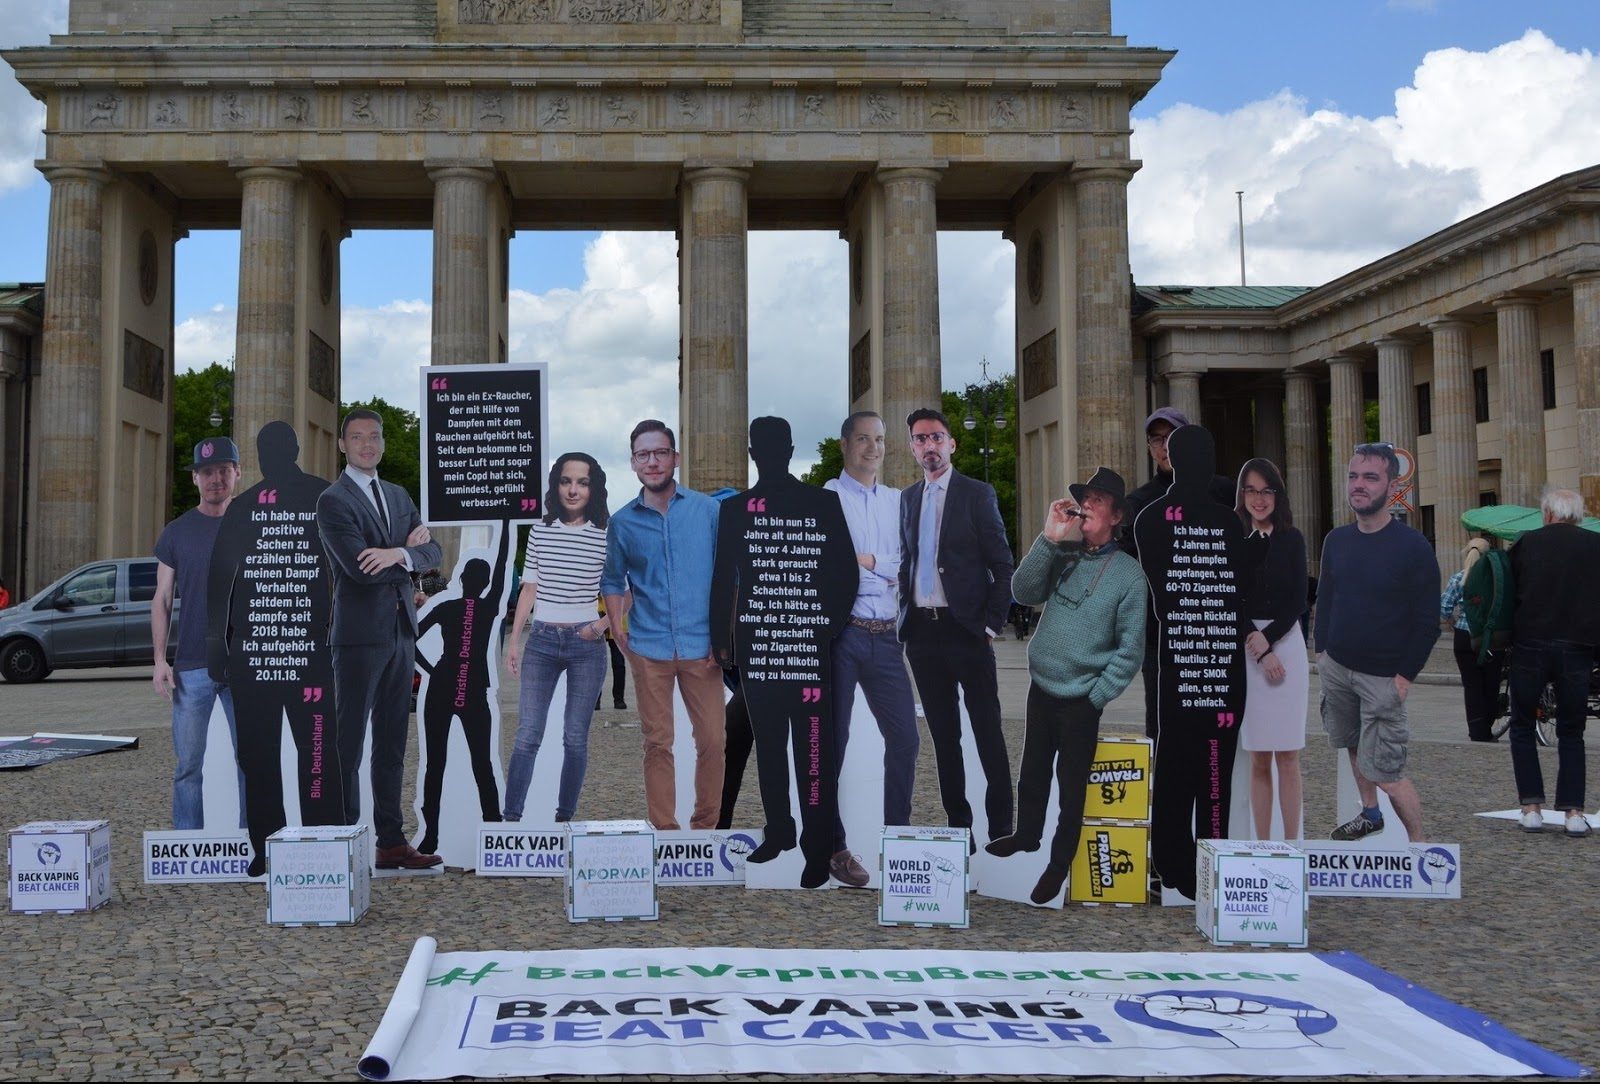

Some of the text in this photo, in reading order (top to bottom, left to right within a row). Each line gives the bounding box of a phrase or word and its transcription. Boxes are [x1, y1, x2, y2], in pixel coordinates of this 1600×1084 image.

[437, 392, 532, 402] Ich bin ein Ex-Raucher,
[450, 405, 519, 414] der mit Hilfe von
[448, 418, 521, 429] Dampfen mit dem
[436, 431, 534, 441] Rauchen aufgehört hat.
[438, 444, 532, 454] Seit dem bekomme ich
[439, 458, 531, 468] besser Luft und sogar
[444, 471, 526, 482] mein Copd hat sich,
[446, 484, 524, 495] zumindest, gefühlt
[461, 498, 509, 507] verbessert.
[252, 510, 316, 520] Ich habe nur
[754, 517, 767, 526] Ich
[770, 517, 783, 526] bin
[805, 518, 816, 527] 53
[262, 525, 304, 537] positive
[744, 530, 826, 541] Jahre alt und habe
[1174, 526, 1186, 535] Ich
[1189, 526, 1208, 535] habe
[256, 539, 309, 549] Sachen zu
[749, 544, 762, 553] bis
[791, 546, 821, 555] Jahren
[1181, 540, 1225, 550] Jahren mit
[246, 553, 318, 563] erzählen über
[753, 558, 817, 569] stark geraucht
[1173, 554, 1227, 565] dem dampfen
[244, 568, 319, 580] meinen Dampf
[759, 573, 802, 582] etwa bis
[1167, 568, 1217, 580] angefangen,
[256, 582, 306, 592] Verhalten
[753, 586, 801, 596] Schachteln
[1166, 583, 1236, 594] 60-70 Zigaretten
[250, 597, 311, 607] seitdem ich
[748, 600, 808, 611] Tag. Ich hätte
[1179, 597, 1224, 606] ohne einen
[249, 611, 311, 624] dampfe seit
[740, 614, 829, 625] ohne die Zigarette
[1167, 611, 1236, 622] einzigen Rückfall
[252, 626, 307, 636] 2018 habe
[755, 628, 814, 639] nie geschafft
[1168, 625, 1236, 636] auf 18mg Nikotin
[243, 641, 315, 653] ich aufgehört
[752, 642, 817, 653] von Zigaretten
[1168, 640, 1236, 651] Liquid mit einem
[455, 599, 474, 707] Christina, Deutschland
[249, 655, 308, 666] zu rauchen
[750, 656, 766, 665] und
[787, 657, 819, 666] Nikotin
[1174, 655, 1231, 663] Nautilus auf
[256, 670, 300, 680] 20.11.18.
[748, 671, 820, 681] weg kommen.
[1180, 669, 1227, 678] einer SMOK
[1194, 697, 1226, 707] einfach.
[311, 715, 323, 798] Bilo, Deutschland
[809, 717, 819, 805] Hans, Deutschland
[1209, 739, 1219, 799] Deutschland
[1090, 769, 1141, 783] PRAWO
[485, 836, 525, 850] BACK
[152, 843, 248, 858] BACK VAPING
[485, 853, 522, 867] BEAT
[889, 860, 930, 871] WORLD
[1097, 834, 1112, 886] PRAWO
[1309, 854, 1411, 870] BACK VAPING
[152, 860, 249, 875] BEAT CANCER
[1089, 843, 1101, 895] DLA LUDZI
[18, 872, 79, 882] BACK VAPING
[274, 874, 345, 885] APORVAP
[577, 868, 650, 880] APORVAP
[1224, 877, 1268, 888] WORLD
[1309, 872, 1412, 888] BEAT CANCER
[18, 882, 79, 892] BEAT CANCER
[889, 885, 931, 894] ALLIANCE
[1224, 904, 1269, 912] ALLIANCE
[496, 998, 1083, 1020] BACK VAPING
[490, 1019, 1112, 1043] BEAT CANCER
